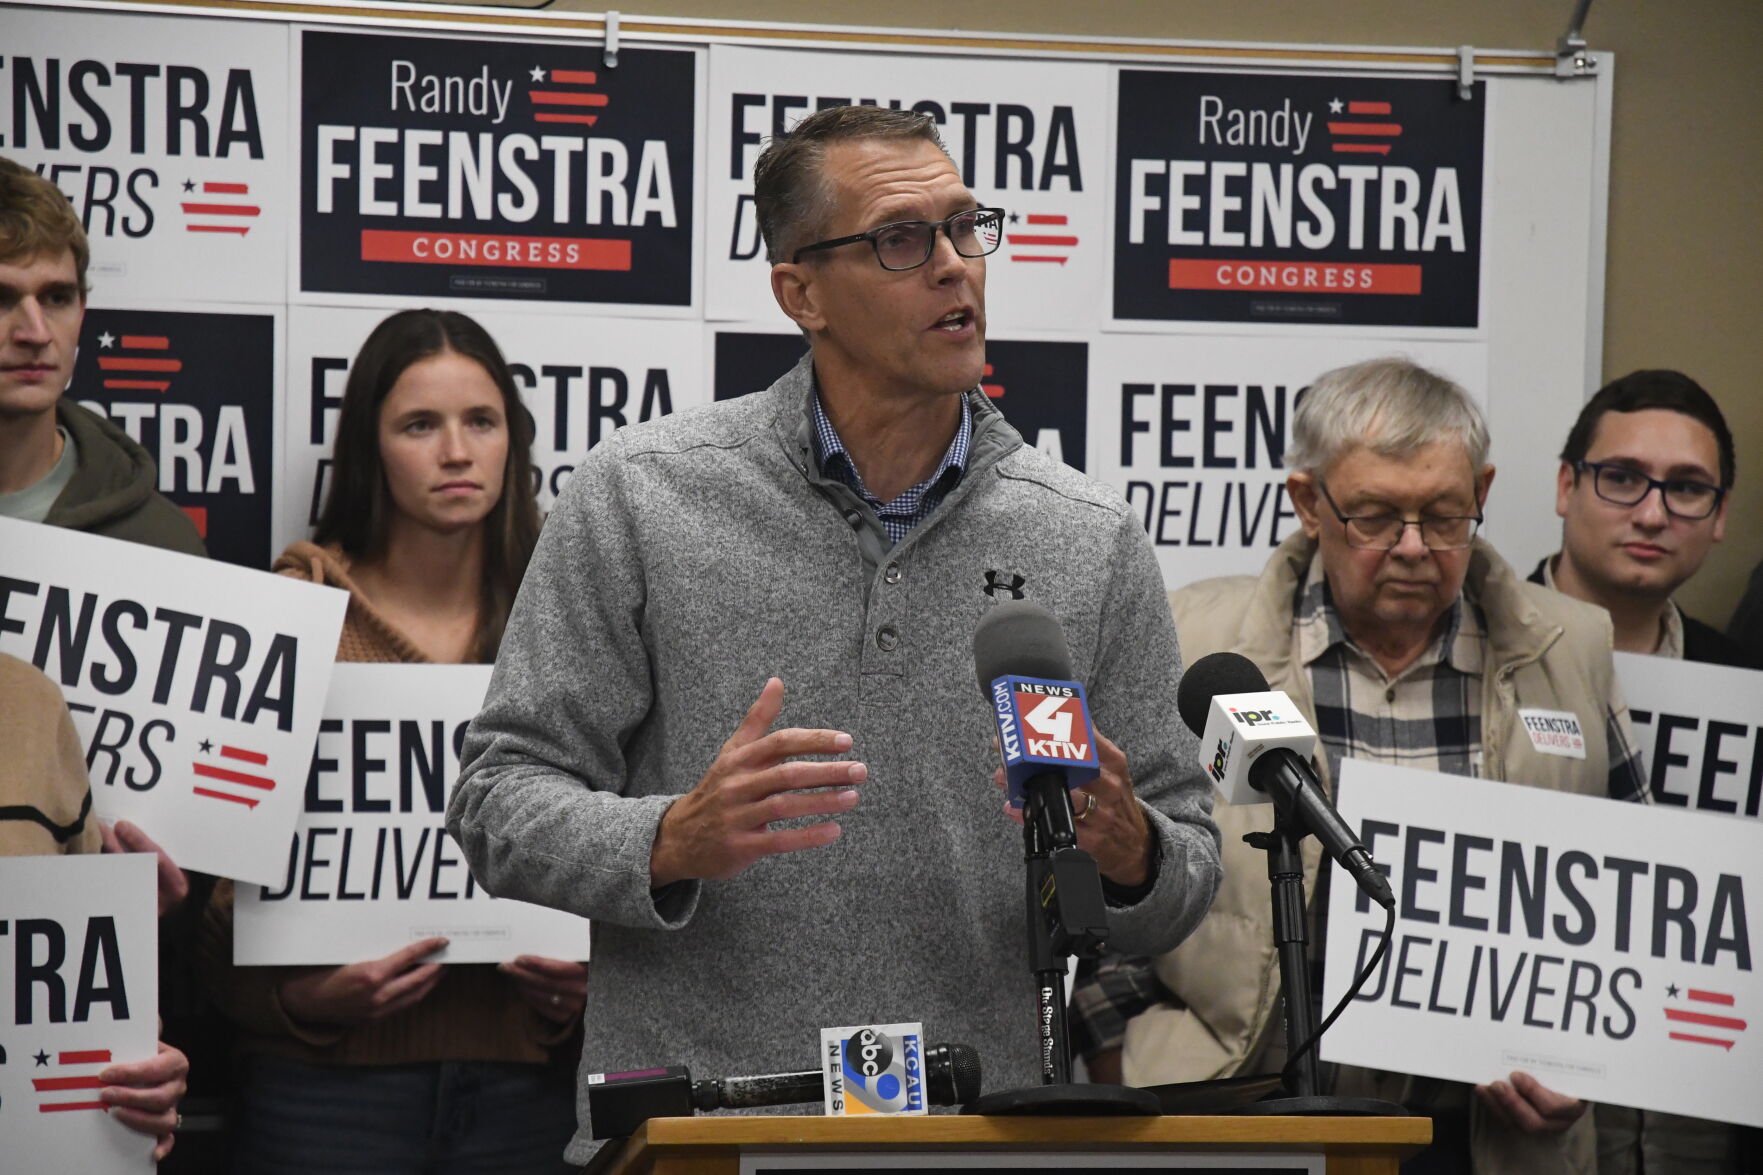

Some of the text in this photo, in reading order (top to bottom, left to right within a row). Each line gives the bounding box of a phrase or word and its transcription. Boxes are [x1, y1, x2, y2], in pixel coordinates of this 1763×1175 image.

[0, 56, 265, 160] NSTRA
[391, 60, 513, 124] Randy
[1199, 95, 1313, 155] Randy
[316, 124, 678, 228] FEENSTRA
[1128, 159, 1466, 253] FEENSTRA
[412, 236, 580, 264] CONGRESS
[1216, 266, 1374, 290] CONGRESS
[78, 400, 255, 494] TRA
[1121, 383, 1312, 469] FEEN
[993, 681, 1021, 761] KTIV.COM
[1020, 683, 1073, 697] NEWS
[1024, 696, 1073, 742] 4
[1027, 738, 1088, 760] KTIV
[1524, 716, 1581, 735] FEENSTRA
[305, 719, 471, 813] EEN
[1355, 818, 1753, 972] FEENSTRA
[0, 916, 130, 1025] RA
[1353, 928, 1642, 1041] DELIVERS
[829, 1045, 844, 1111] NEWS
[860, 1029, 882, 1076] abc
[904, 1040, 920, 1105] KCAU
